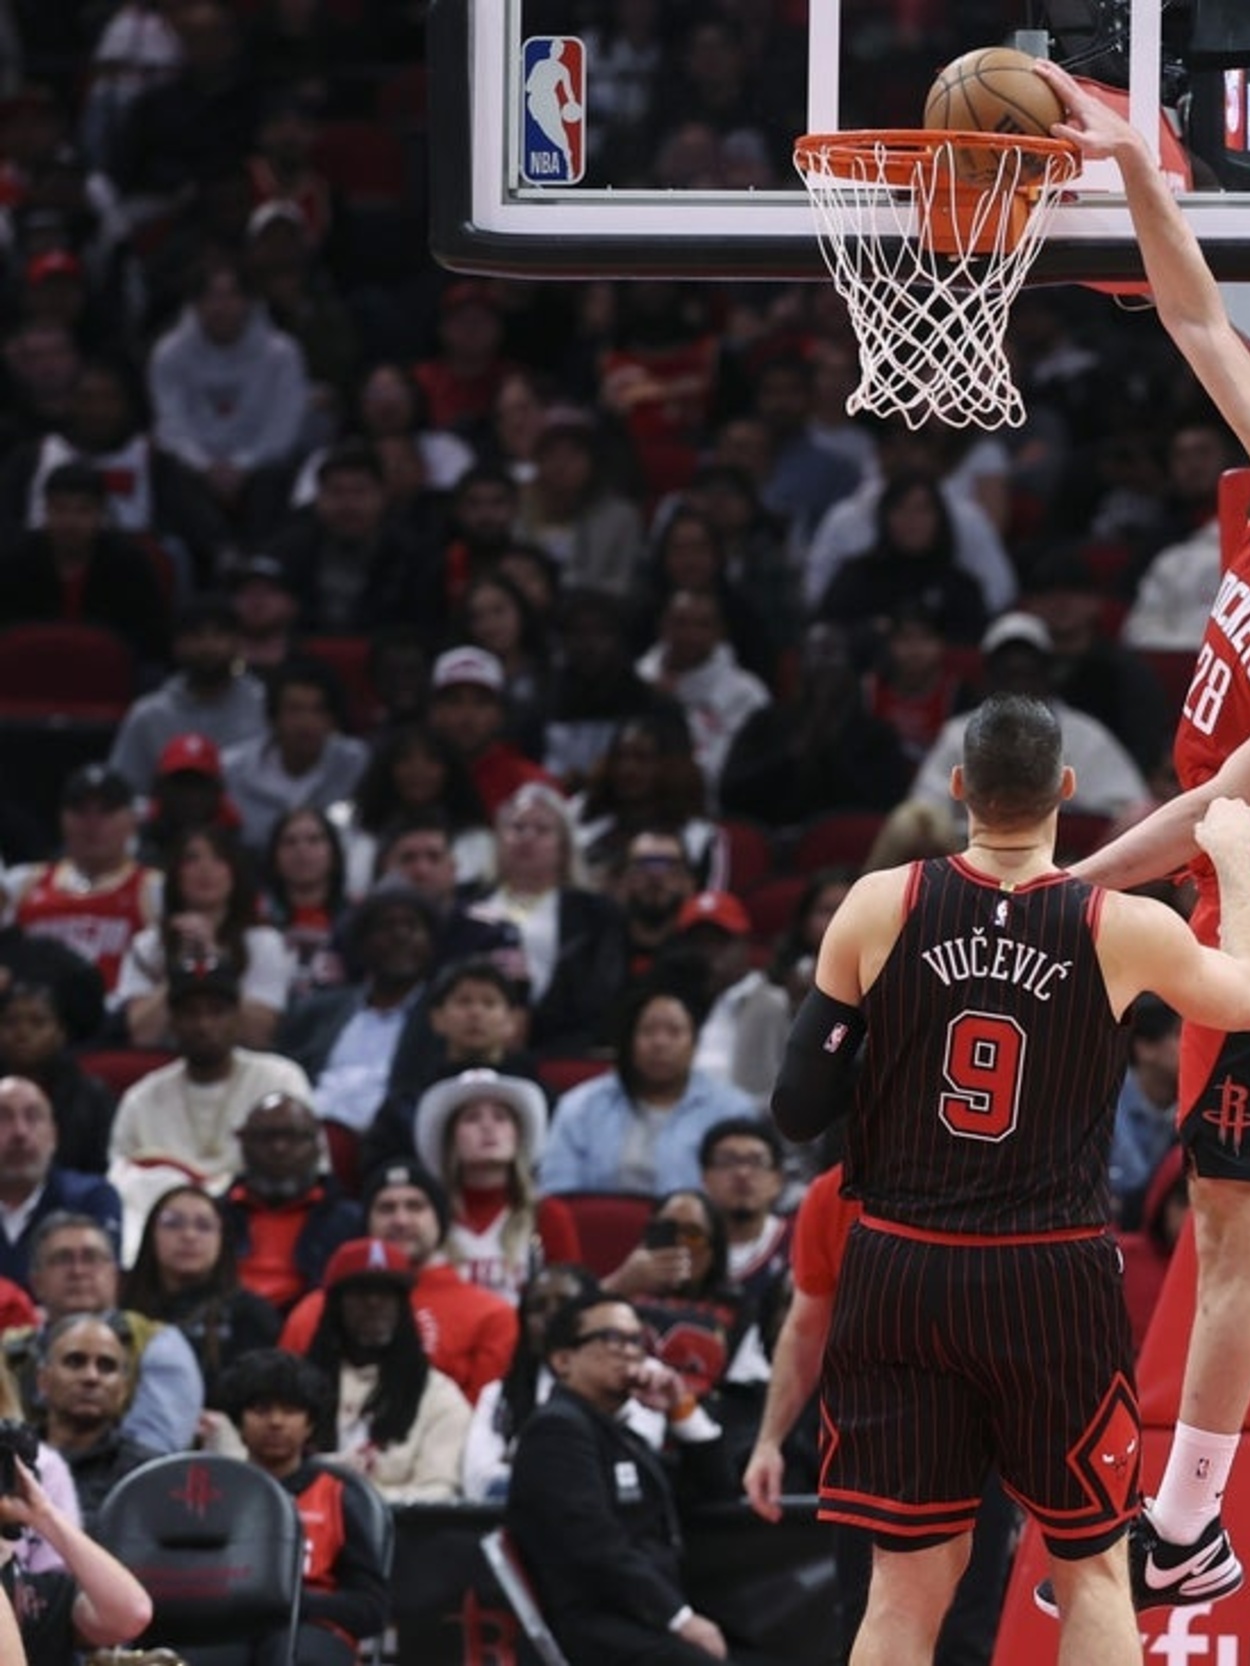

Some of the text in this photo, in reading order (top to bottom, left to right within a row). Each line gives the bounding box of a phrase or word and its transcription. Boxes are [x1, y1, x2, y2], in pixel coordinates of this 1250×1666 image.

[529, 151, 560, 174] NBA
[1182, 640, 1232, 736] 28
[921, 926, 1074, 1001] VUČEVIĆ
[937, 1008, 1027, 1143] 9
